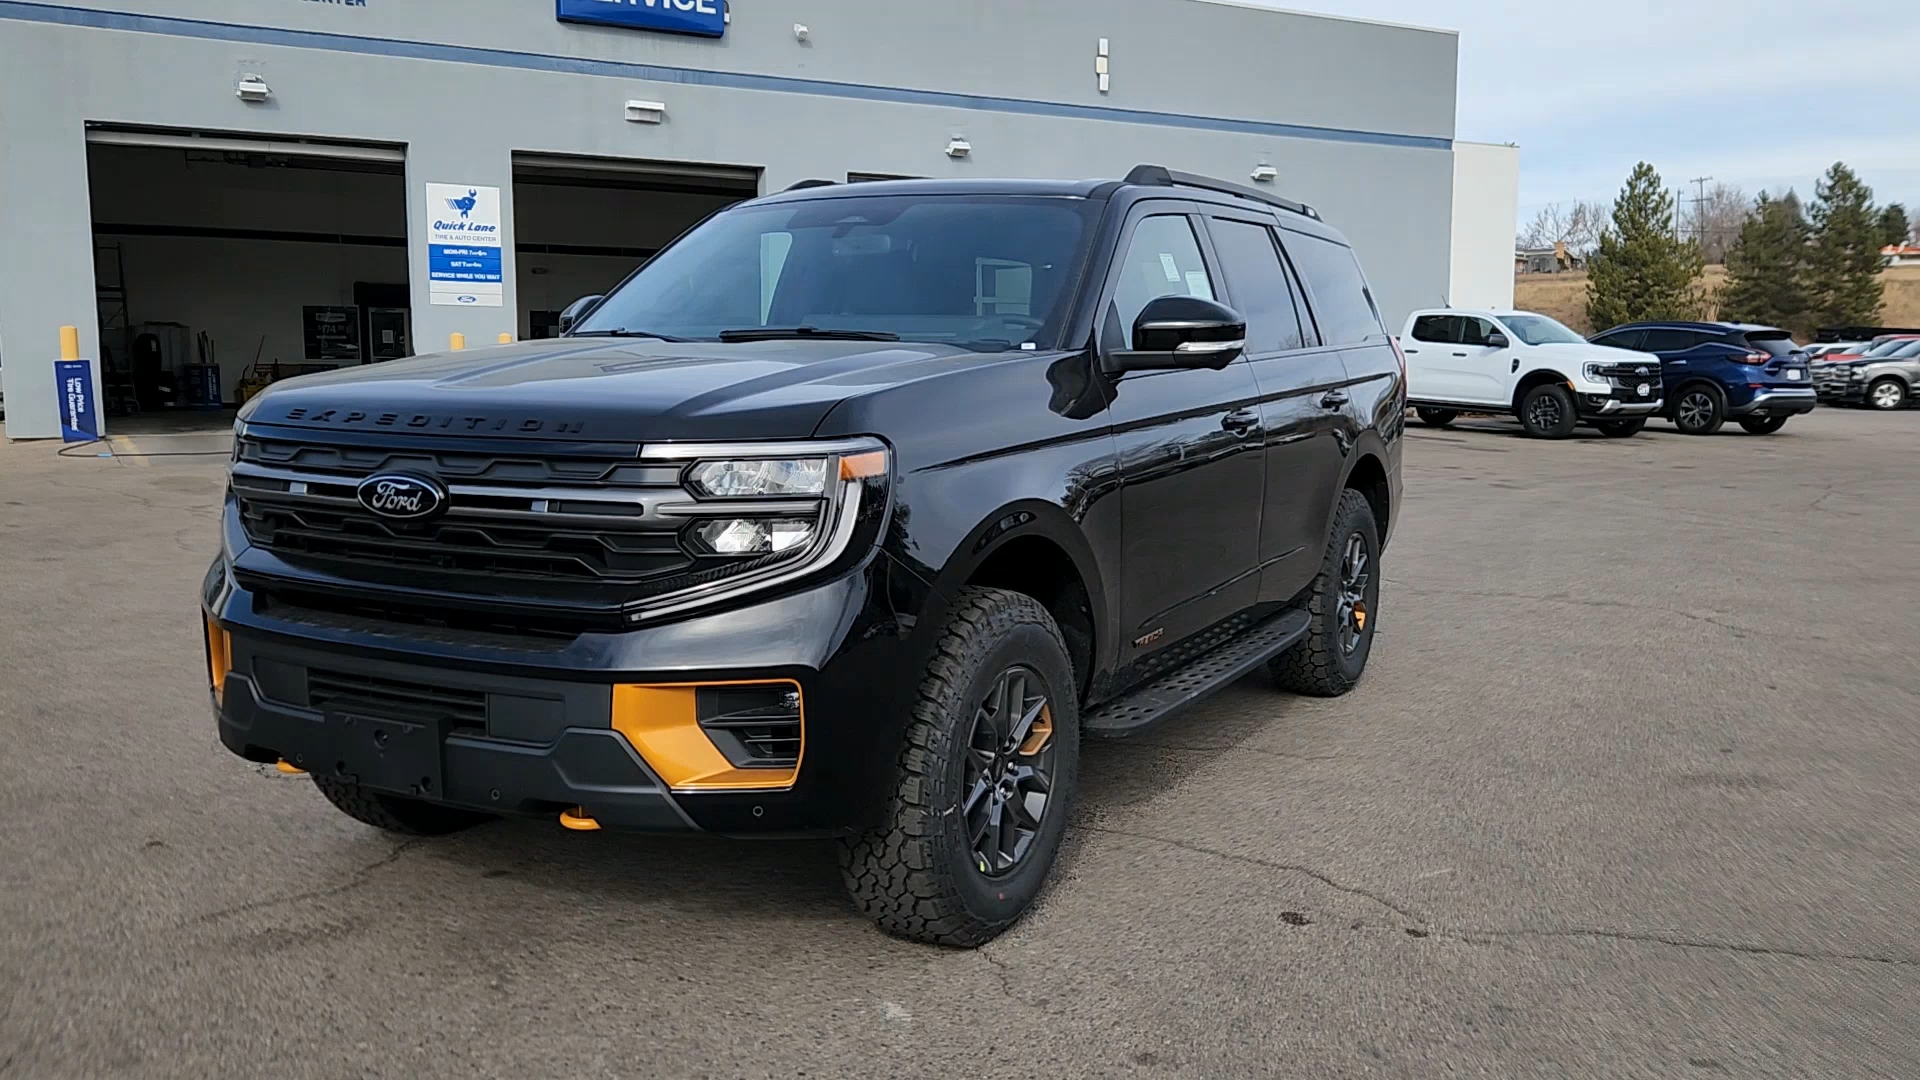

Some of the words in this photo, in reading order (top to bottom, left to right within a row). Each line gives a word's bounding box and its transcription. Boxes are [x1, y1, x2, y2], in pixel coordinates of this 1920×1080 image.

[433, 220, 466, 231] Quick
[467, 222, 496, 232] Lane
[66, 377, 75, 393] Tire
[74, 377, 83, 394] Low
[76, 394, 85, 413] Price
[285, 407, 586, 435] EXPEDITION
[372, 481, 423, 512] Ford
